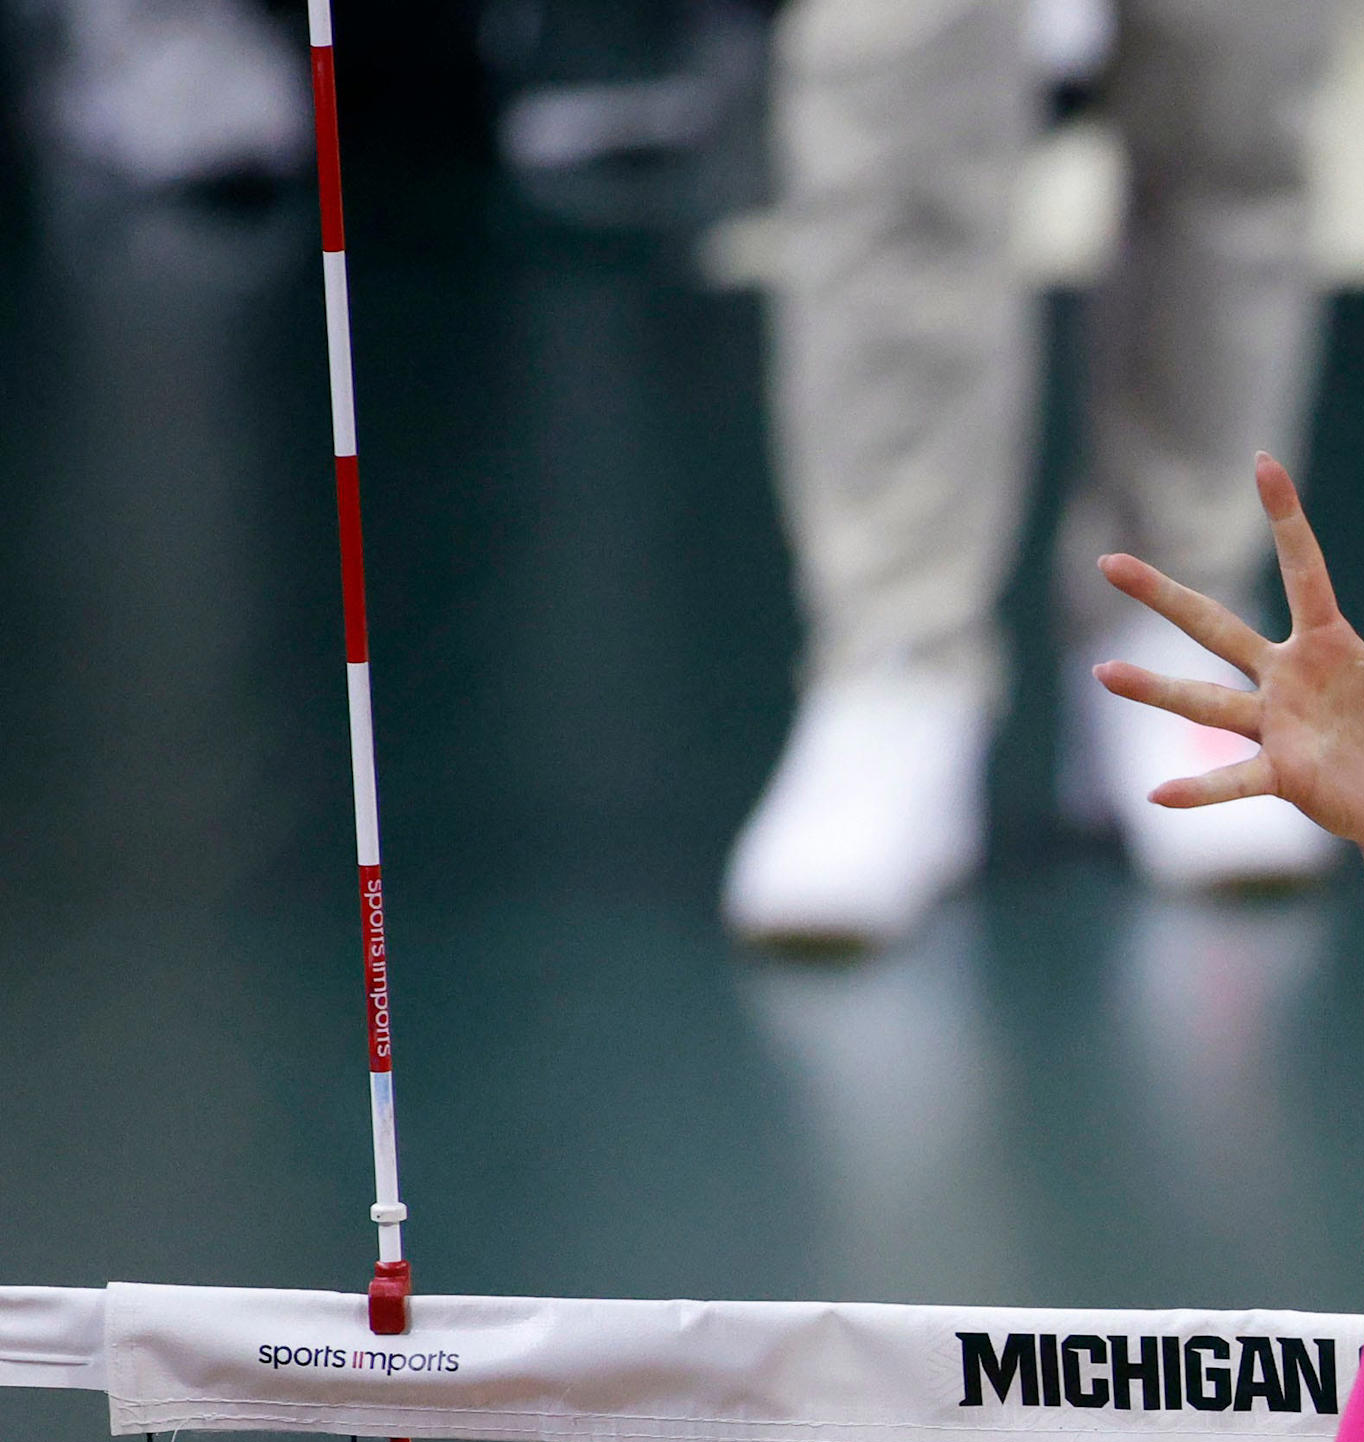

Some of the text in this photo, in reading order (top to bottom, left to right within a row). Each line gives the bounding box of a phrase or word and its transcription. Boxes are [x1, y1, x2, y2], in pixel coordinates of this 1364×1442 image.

[364, 879, 386, 957] sports
[258, 1344, 346, 1369] sports
[955, 1331, 1340, 1415] MICHIGAN
